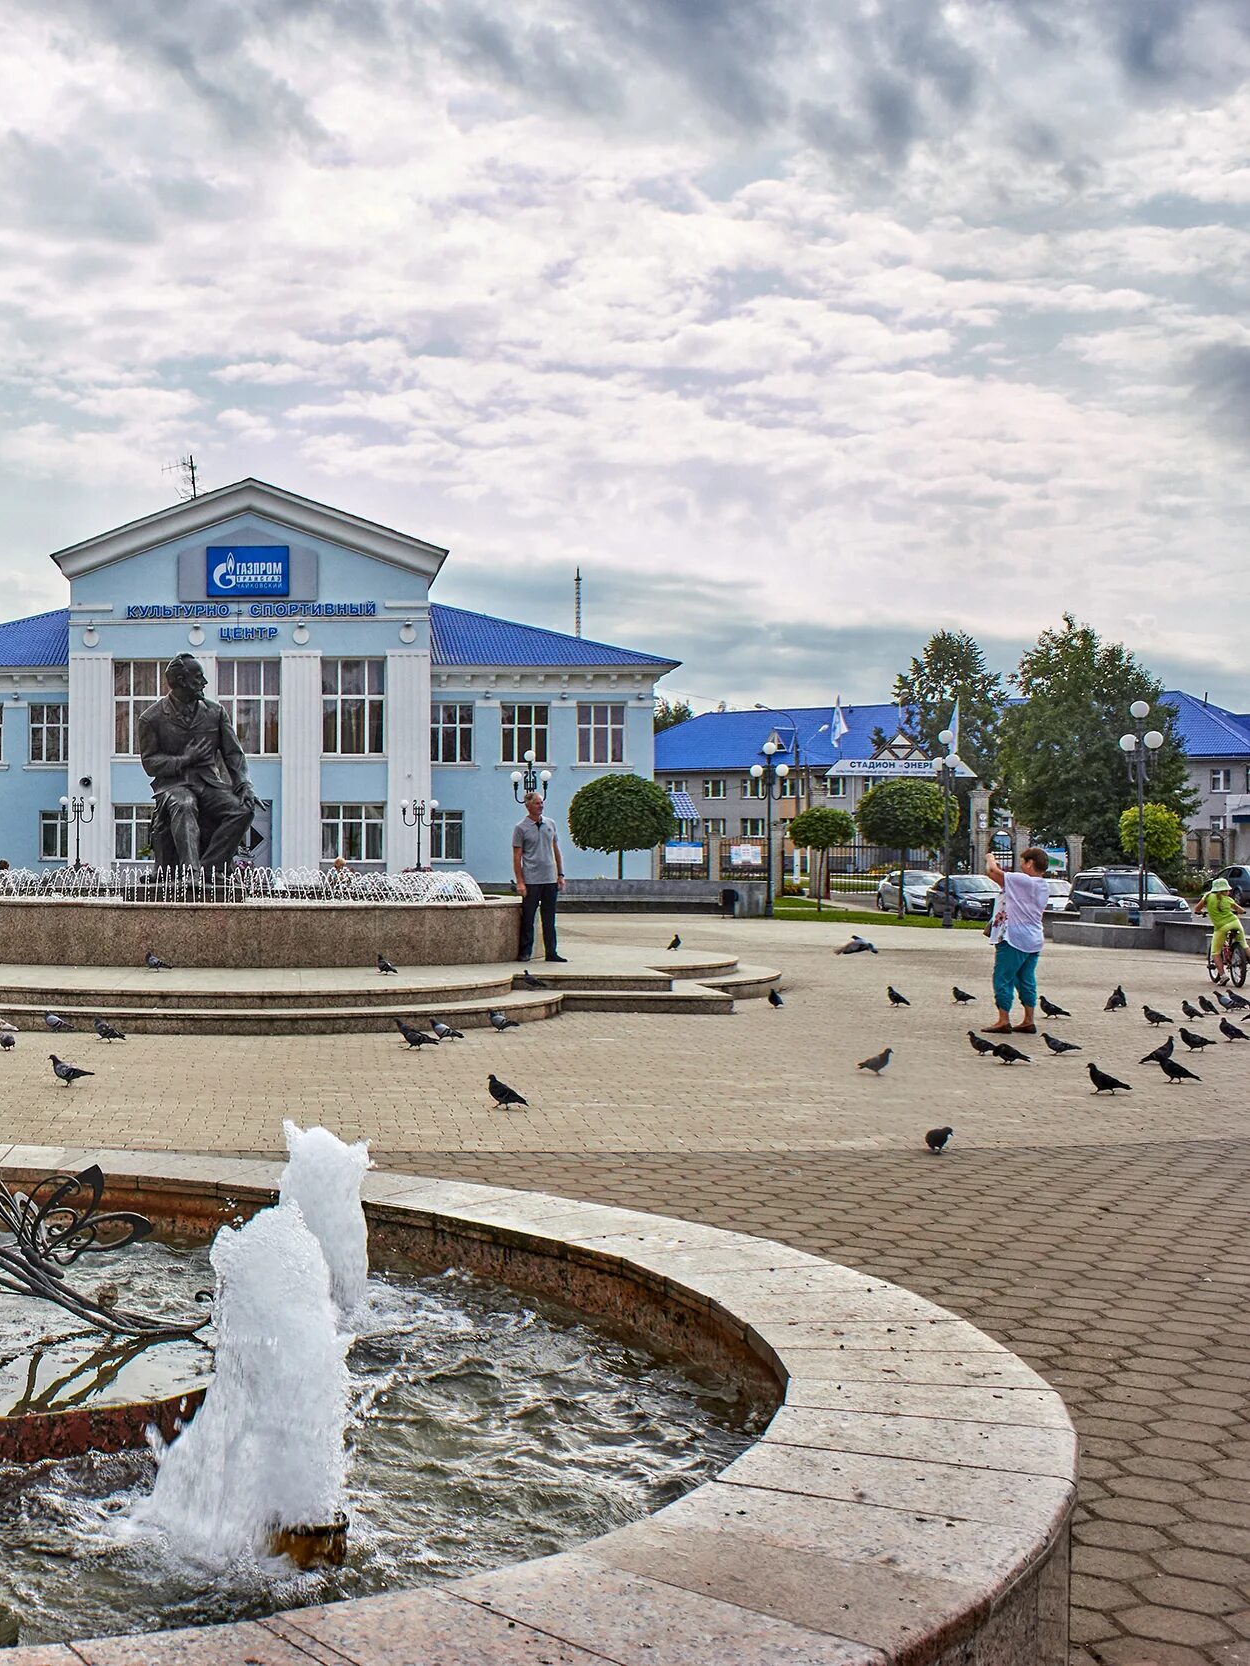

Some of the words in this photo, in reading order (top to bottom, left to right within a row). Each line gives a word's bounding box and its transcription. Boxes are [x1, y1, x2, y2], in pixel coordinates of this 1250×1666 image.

[236, 562, 282, 575] ГАЗПРОМ
[127, 604, 230, 618] КУЛЬТУРНО
[249, 601, 377, 617] СПОРТИВНЫЙ
[219, 627, 279, 641] ЦЕНТР
[849, 761, 896, 769] СТАДИОН
